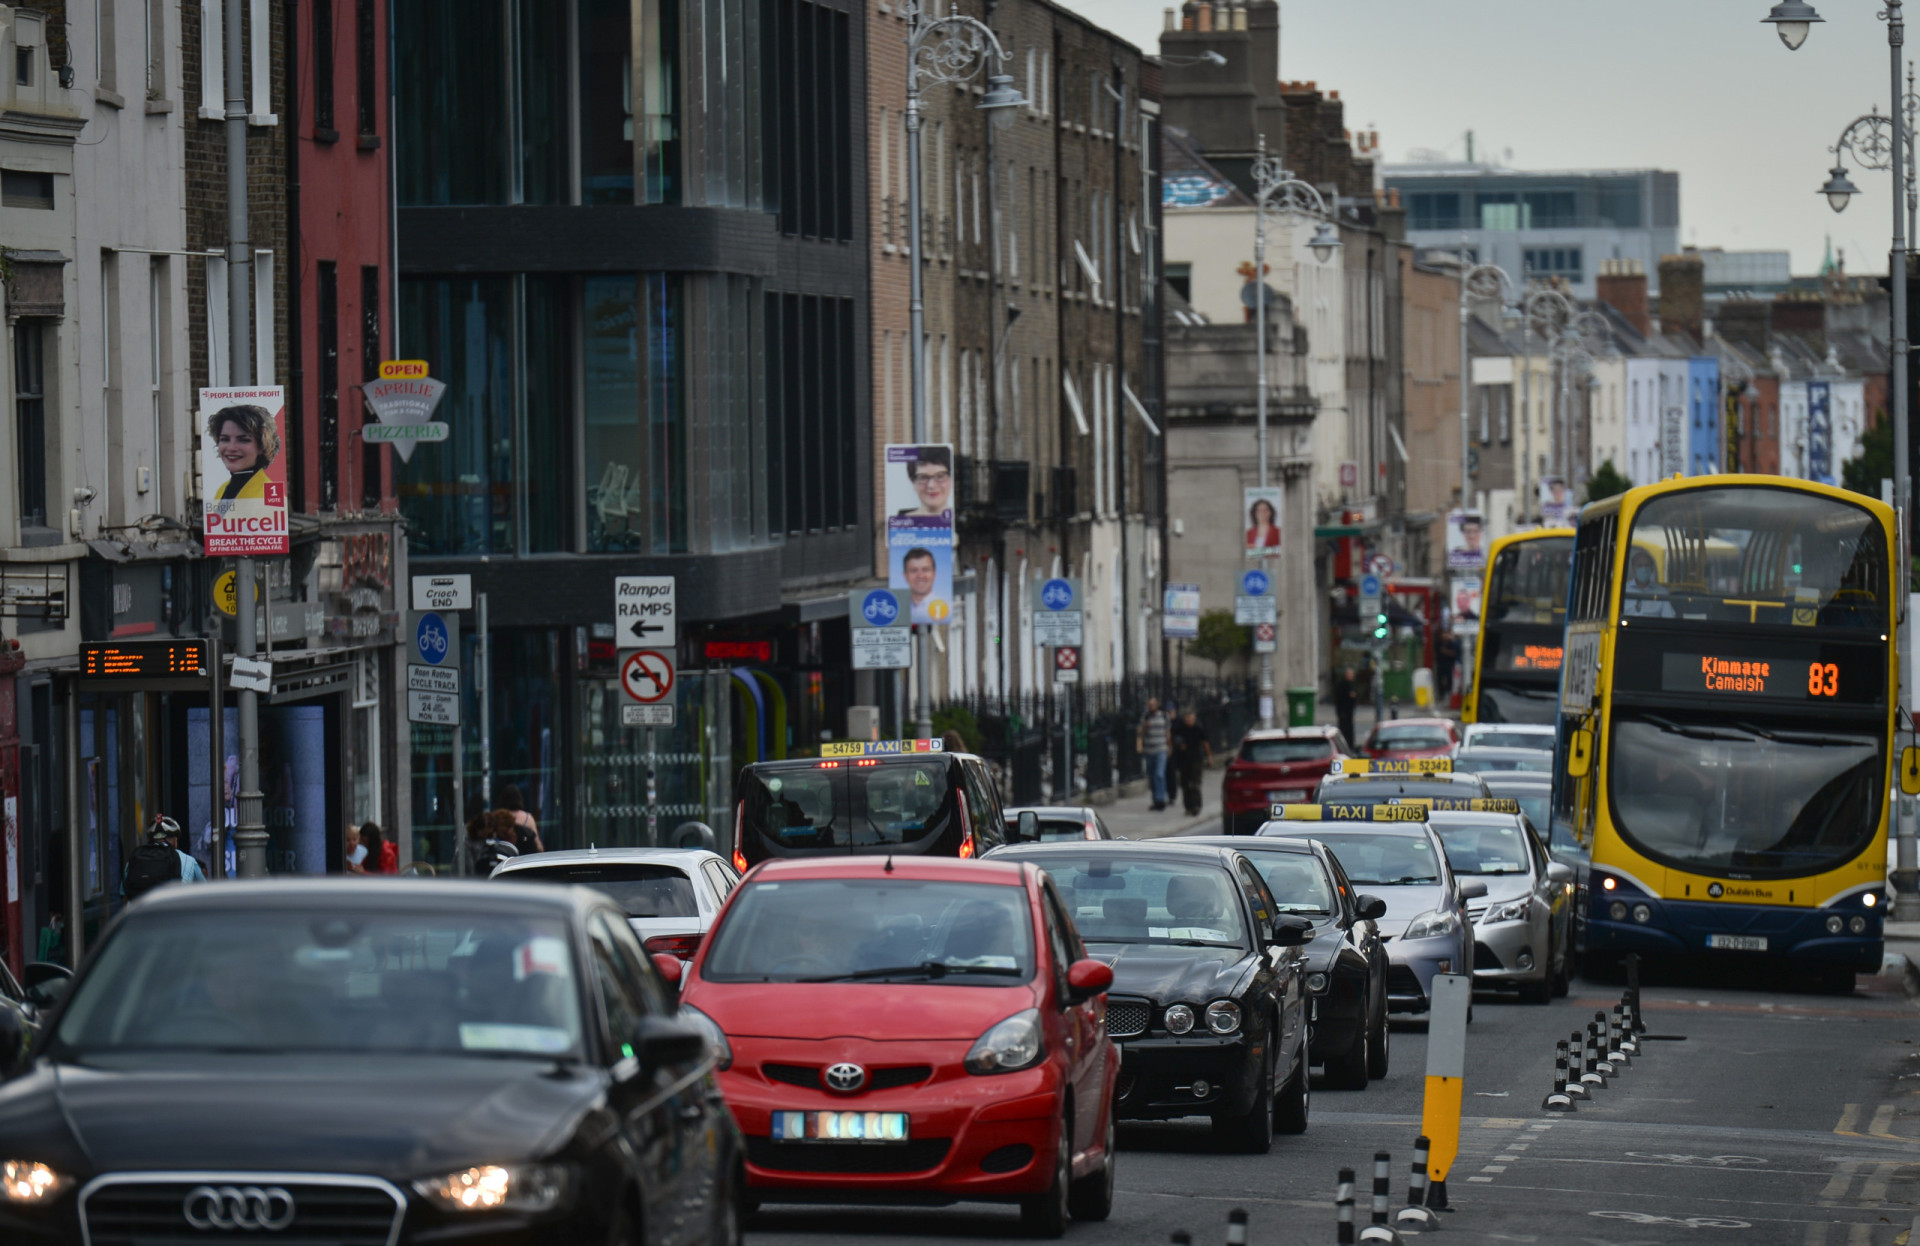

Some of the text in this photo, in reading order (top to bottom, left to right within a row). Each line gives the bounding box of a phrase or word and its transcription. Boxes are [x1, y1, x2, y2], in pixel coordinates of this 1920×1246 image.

[384, 364, 423, 375] OPEN
[367, 425, 442, 439] PIZZERIA
[270, 485, 278, 497] 1
[205, 502, 235, 513] Brigid
[206, 510, 286, 533] Purcell
[209, 536, 283, 546] BREAK THE CYCLE
[431, 598, 453, 608] END
[618, 602, 673, 616] RAMPS
[410, 678, 456, 690] CYCLE TRACK
[1808, 662, 1839, 696] 83
[421, 702, 432, 712] 24
[833, 743, 861, 754] 54759
[867, 741, 900, 752] TAXI
[931, 740, 941, 749] D
[1333, 760, 1448, 772] D TAXI 52342
[1435, 799, 1468, 811] TAXI
[1482, 799, 1515, 811] 32030
[1273, 805, 1421, 820] D TAXI 41705
[1725, 886, 1773, 898] Dublin Bus
